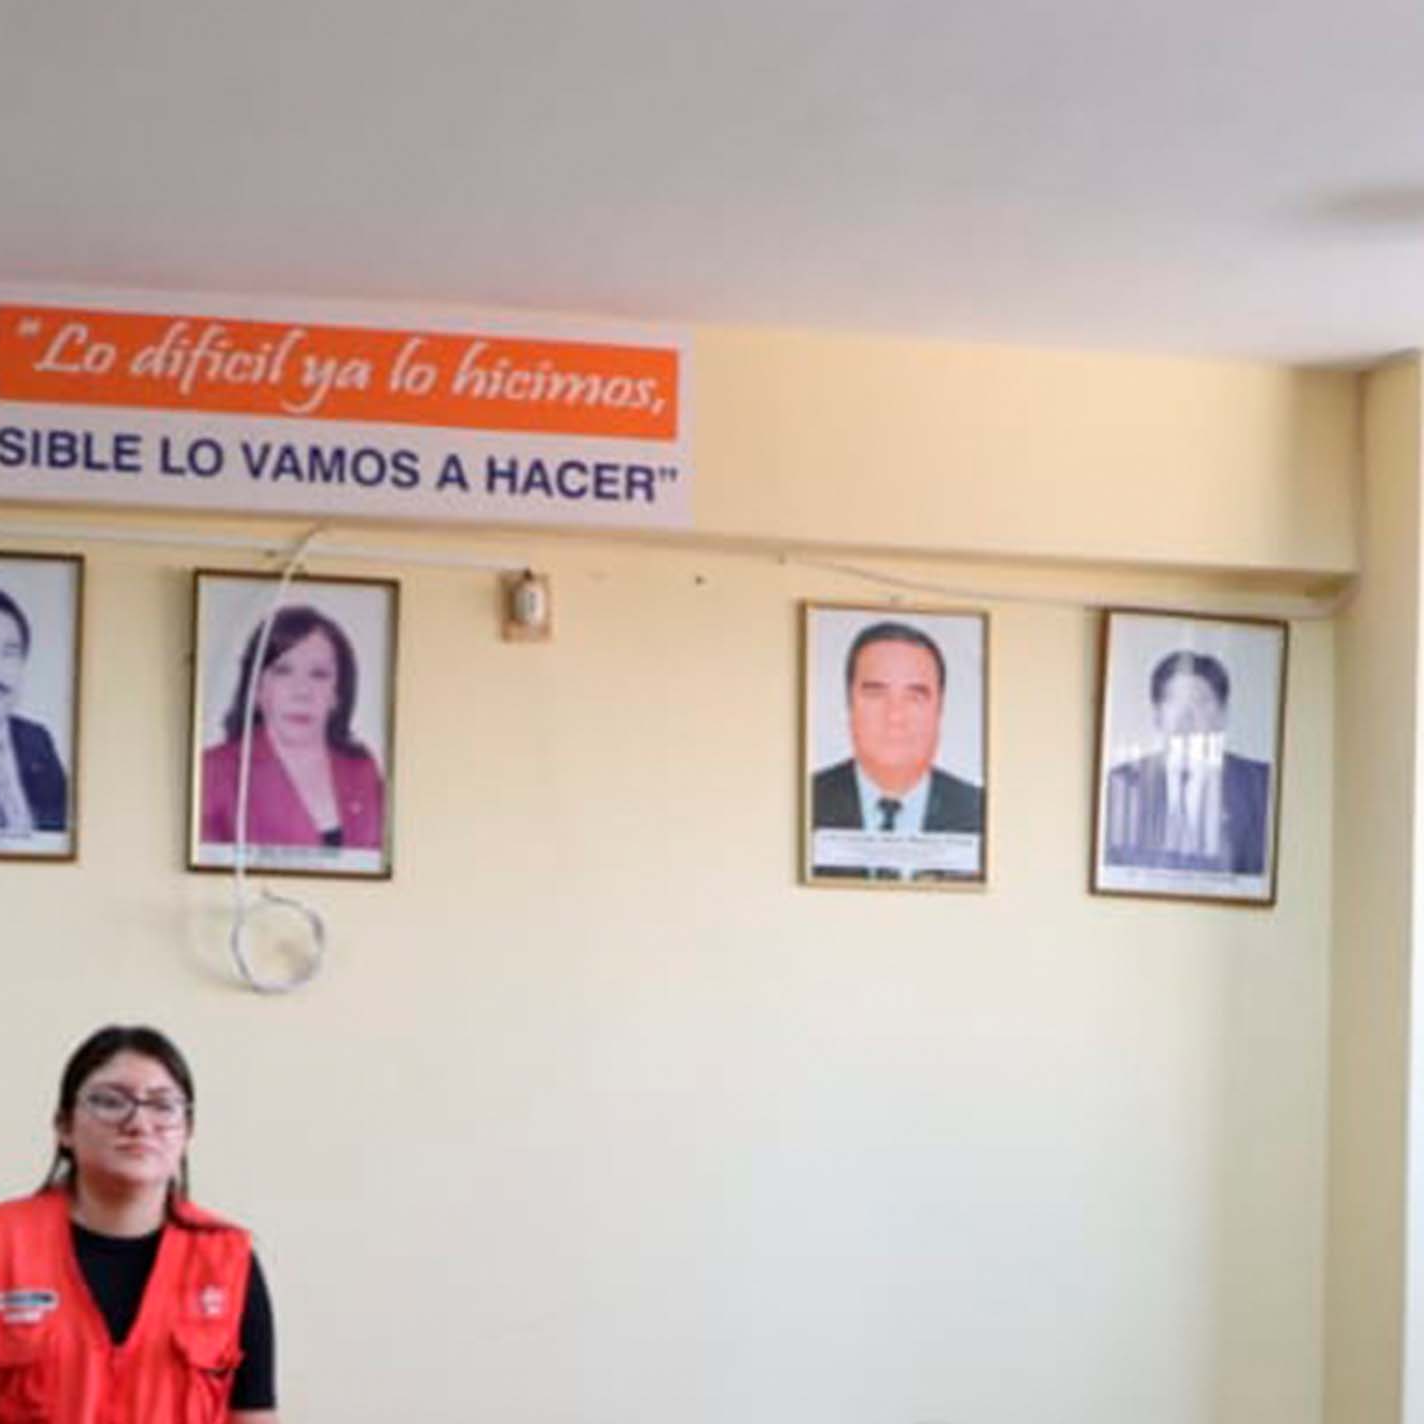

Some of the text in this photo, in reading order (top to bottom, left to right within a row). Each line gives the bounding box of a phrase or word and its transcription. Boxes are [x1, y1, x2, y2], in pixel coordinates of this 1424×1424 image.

[280, 352, 372, 414] ya
[390, 336, 438, 396] lo
[452, 341, 665, 414] hicimos,
[160, 436, 223, 478] LO
[241, 442, 421, 489] VAMOS
[436, 453, 469, 492] A
[486, 456, 677, 501] HACER"
